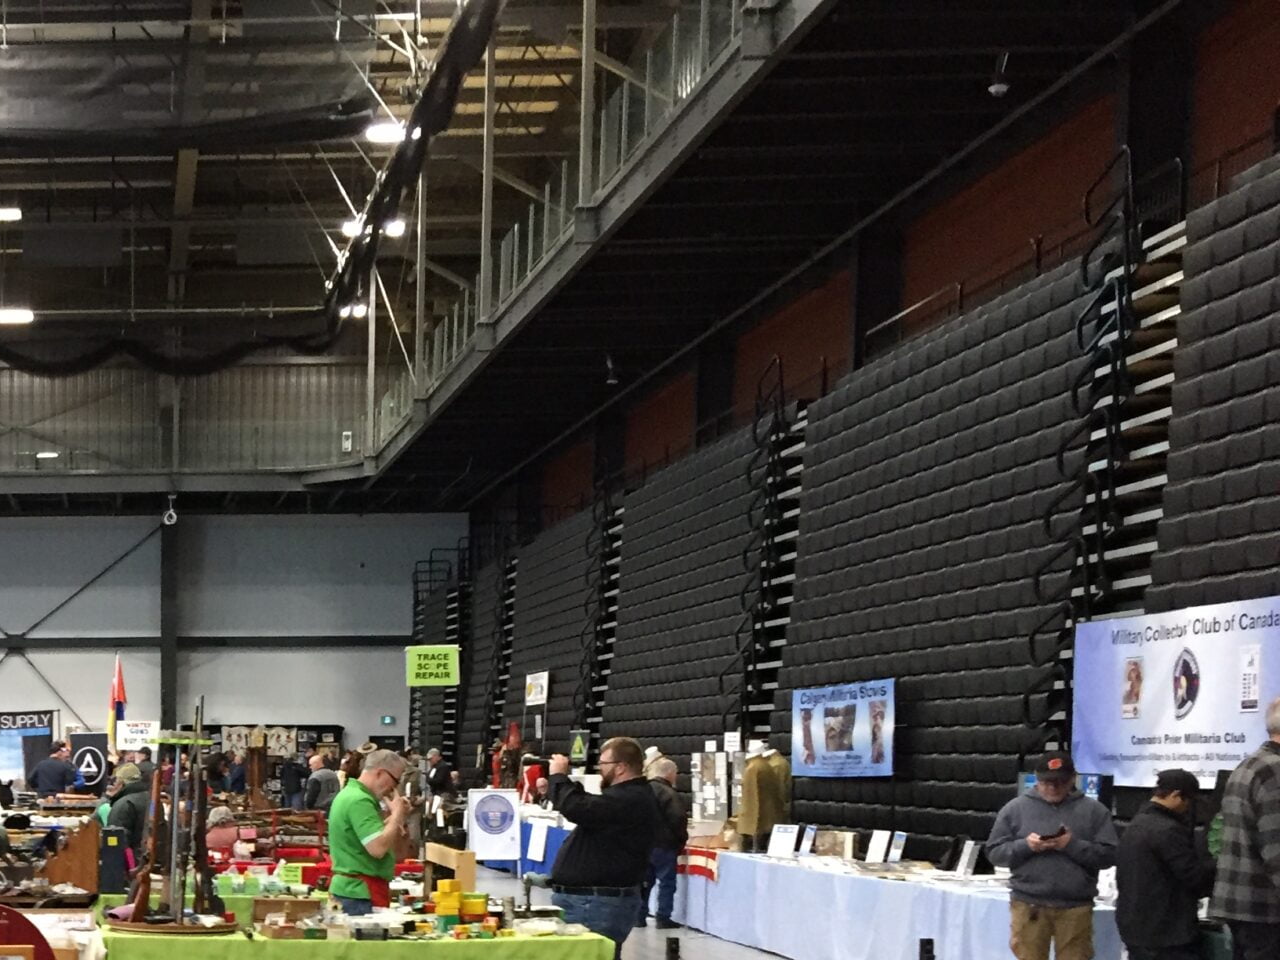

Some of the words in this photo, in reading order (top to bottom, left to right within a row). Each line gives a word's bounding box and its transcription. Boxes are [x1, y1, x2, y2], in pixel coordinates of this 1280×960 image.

[1192, 616, 1221, 636] Club
[1224, 614, 1235, 632] of
[416, 653, 449, 661] TRACE
[0, 713, 51, 729] SUPPLY
[1224, 731, 1246, 744] Club
